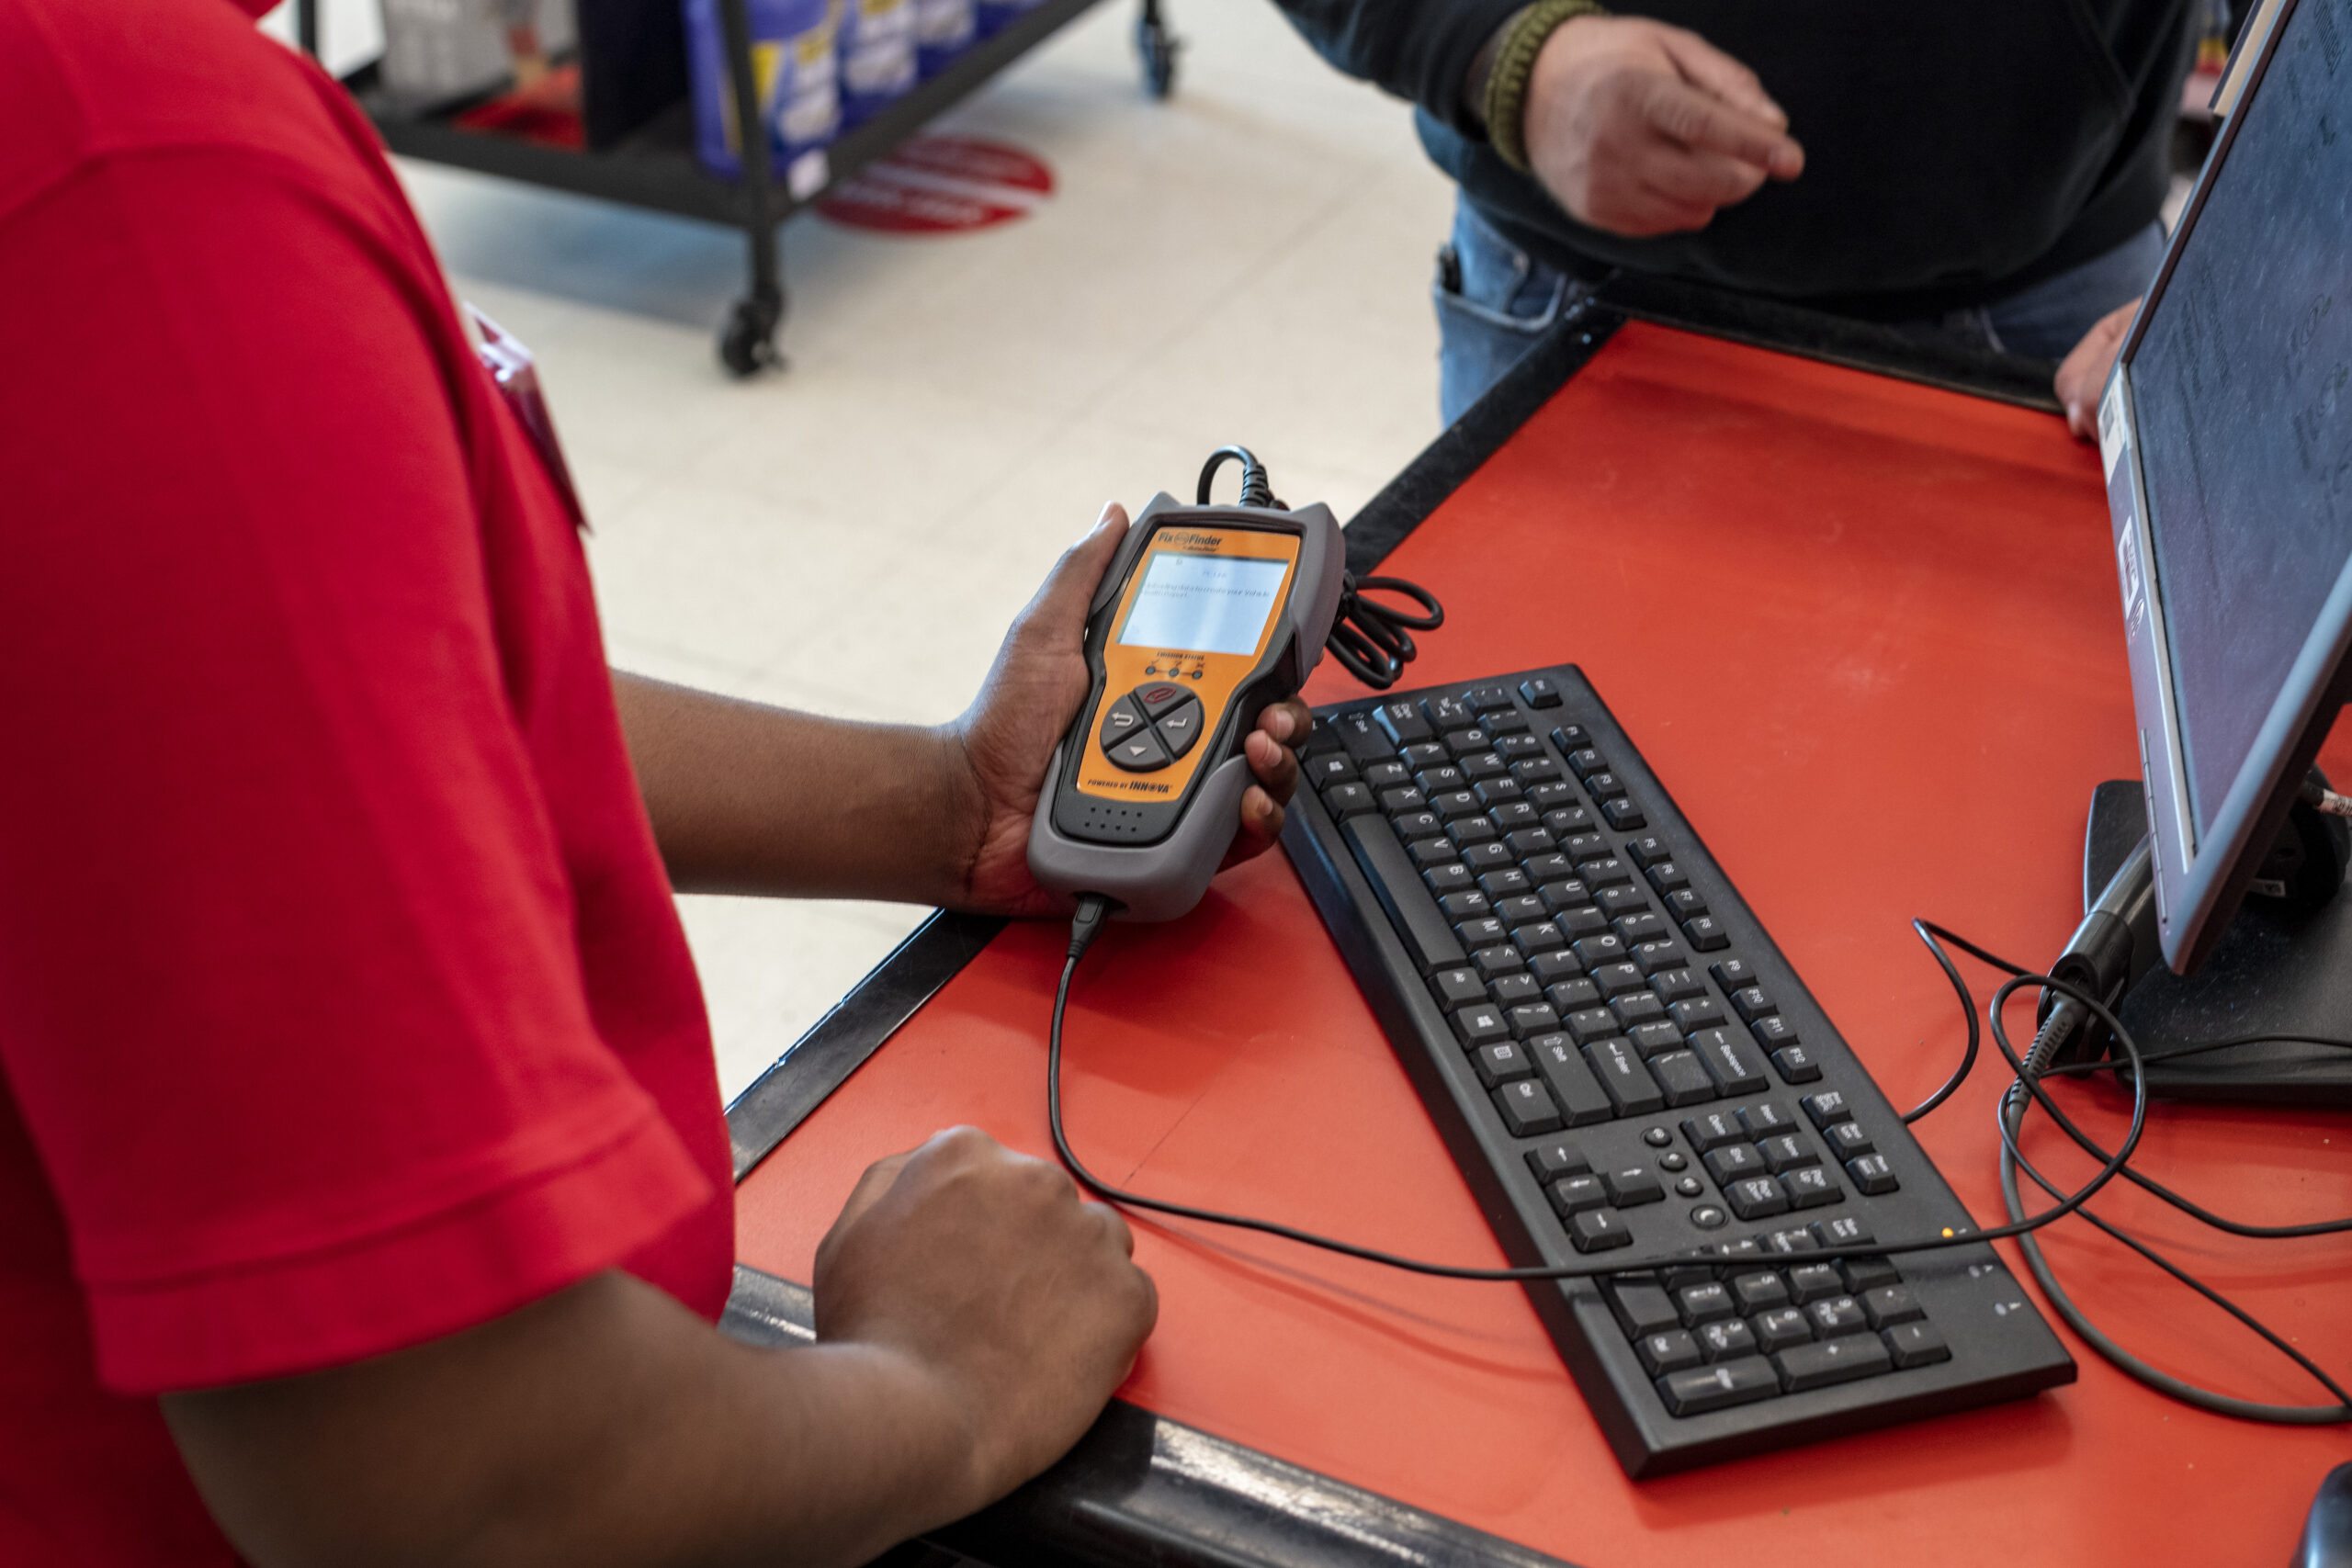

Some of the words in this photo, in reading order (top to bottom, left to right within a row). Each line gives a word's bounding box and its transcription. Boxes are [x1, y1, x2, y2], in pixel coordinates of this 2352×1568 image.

[1158, 532, 1173, 542] Fix
[1189, 535, 1223, 546] Finder
[1468, 731, 1481, 739] Q
[1424, 745, 1439, 753] A
[1485, 754, 1499, 764] W
[1584, 750, 1595, 760] F2
[1387, 764, 1402, 773] Z
[1441, 769, 1454, 777] S
[1088, 779, 1118, 788] POWERED
[1499, 779, 1513, 787] E
[1403, 789, 1417, 798] X
[1456, 793, 1470, 802] D
[1515, 804, 1529, 813] R
[1419, 815, 1433, 823] C
[1532, 829, 1546, 837] T
[1434, 839, 1448, 848] V
[1645, 838, 1656, 848] F5
[1489, 844, 1502, 853] G
[1449, 865, 1464, 874] B
[1663, 864, 1674, 874] F6
[1505, 871, 1521, 881] H
[1566, 882, 1580, 891] U
[1466, 894, 1481, 904] N
[1483, 920, 1498, 931] M
[1539, 924, 1554, 934] K
[1601, 936, 1616, 946] O
[1555, 952, 1570, 961] L
[1619, 964, 1634, 973] P
[1728, 960, 1740, 971] F9
[1748, 989, 1763, 1003] F10
[1769, 1018, 1783, 1032] F11
[1790, 1048, 1805, 1063] F12
[1759, 1276, 1775, 1285] 5
